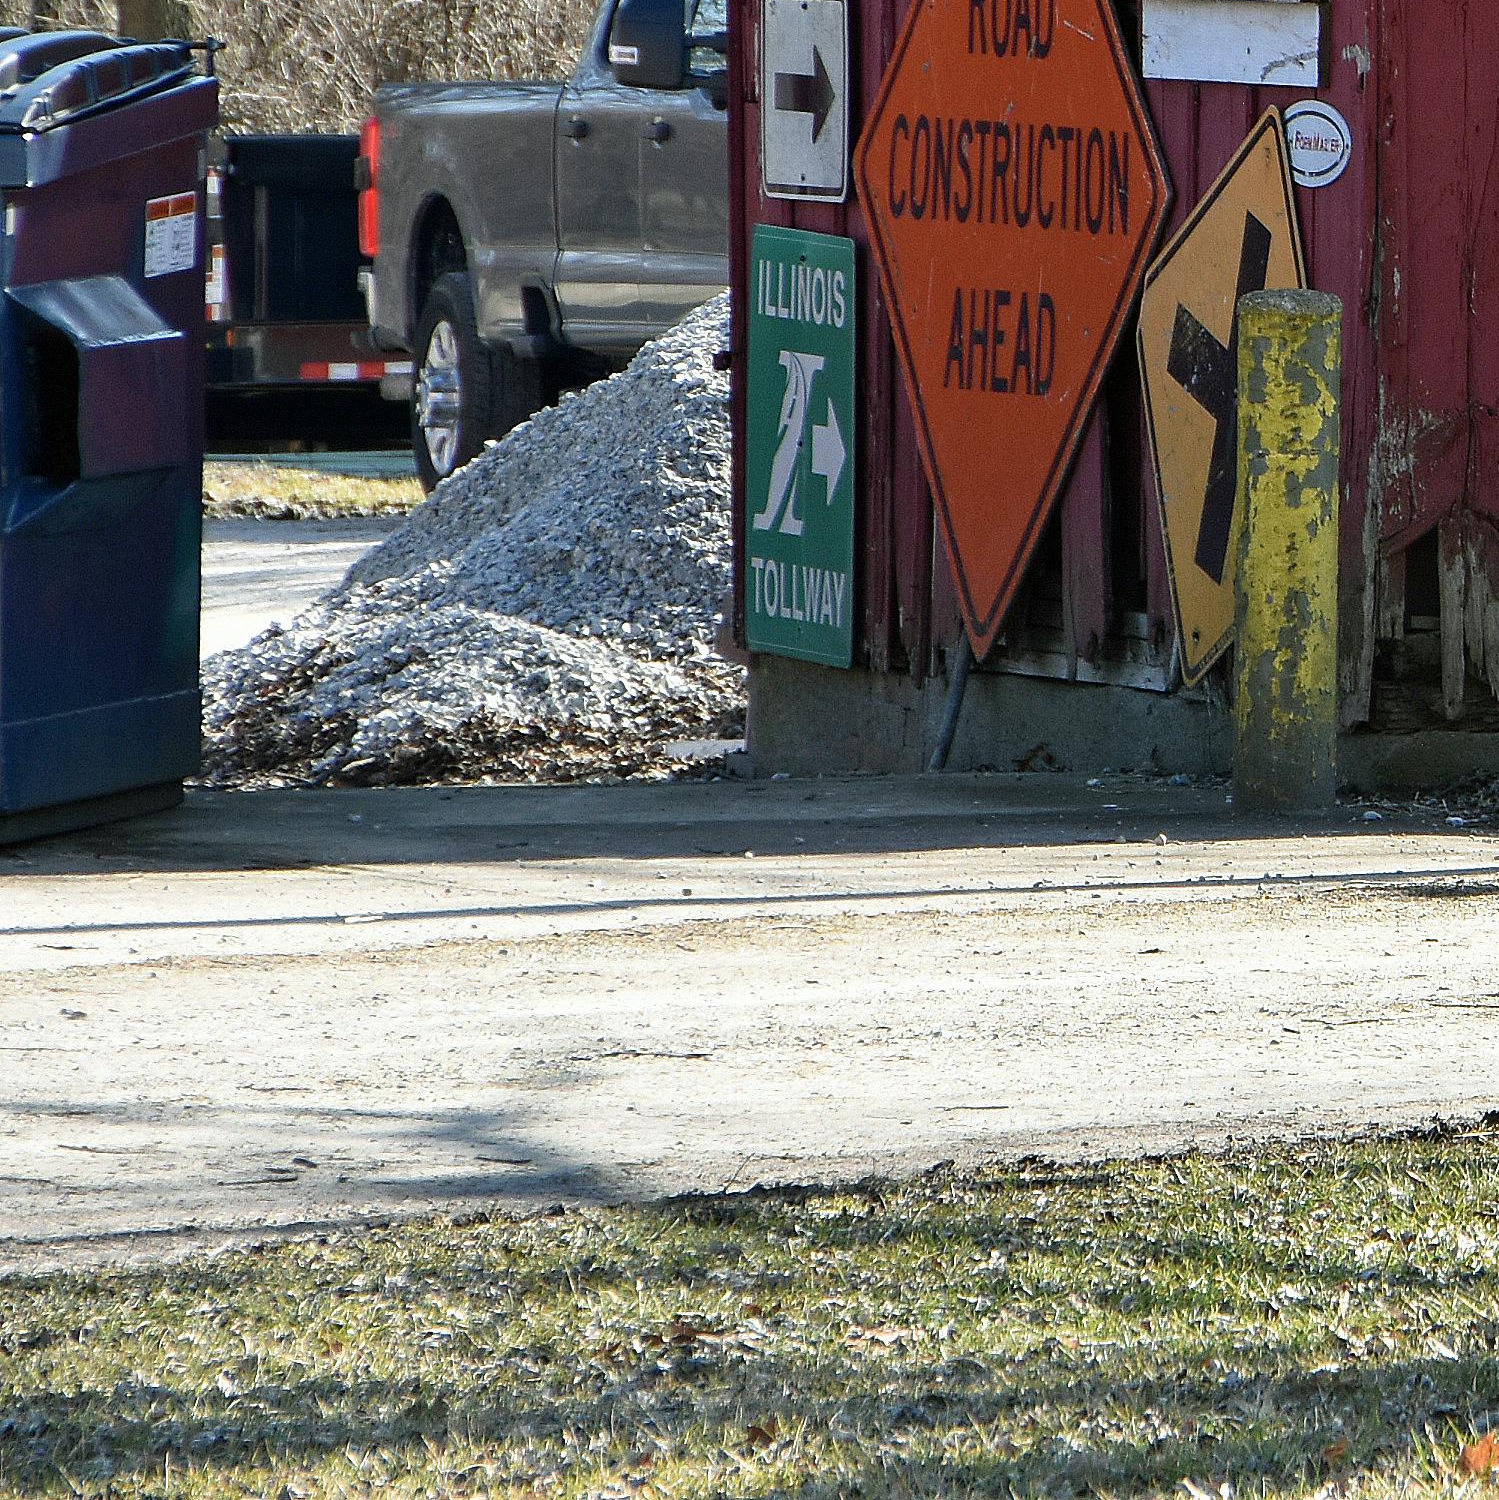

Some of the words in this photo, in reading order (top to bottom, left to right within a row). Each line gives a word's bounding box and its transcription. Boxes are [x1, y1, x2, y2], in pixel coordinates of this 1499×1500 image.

[887, 115, 1130, 236] CONSTRUCTION
[758, 260, 844, 328] ILLINOIS
[942, 287, 1056, 396] AHEAD
[751, 558, 845, 627] TOLLWAY
